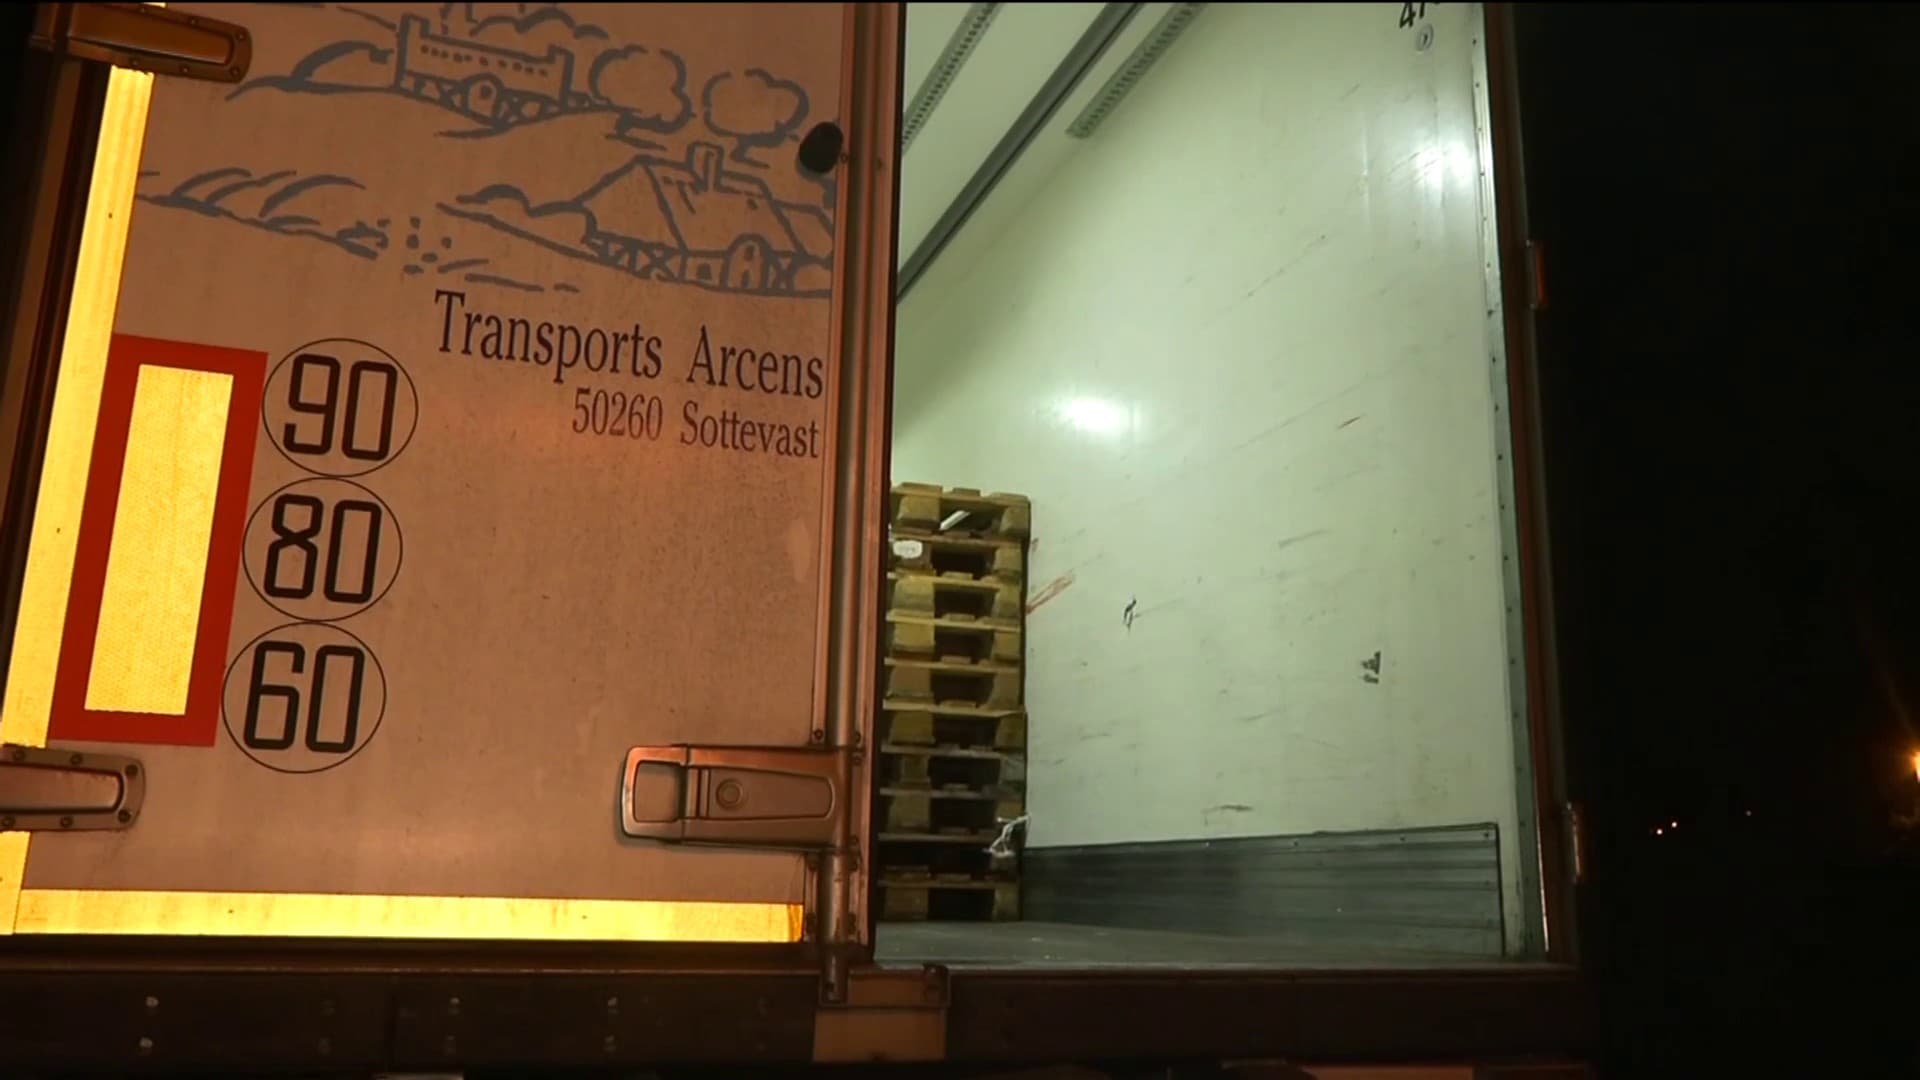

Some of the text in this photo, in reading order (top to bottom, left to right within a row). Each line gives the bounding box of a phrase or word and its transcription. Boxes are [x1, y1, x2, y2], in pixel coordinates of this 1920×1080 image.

[435, 290, 824, 399] Transports Arcens
[283, 353, 398, 461] 90
[572, 387, 820, 459] 50260 Sottevast
[264, 493, 382, 604] 80
[243, 641, 365, 754] 60
